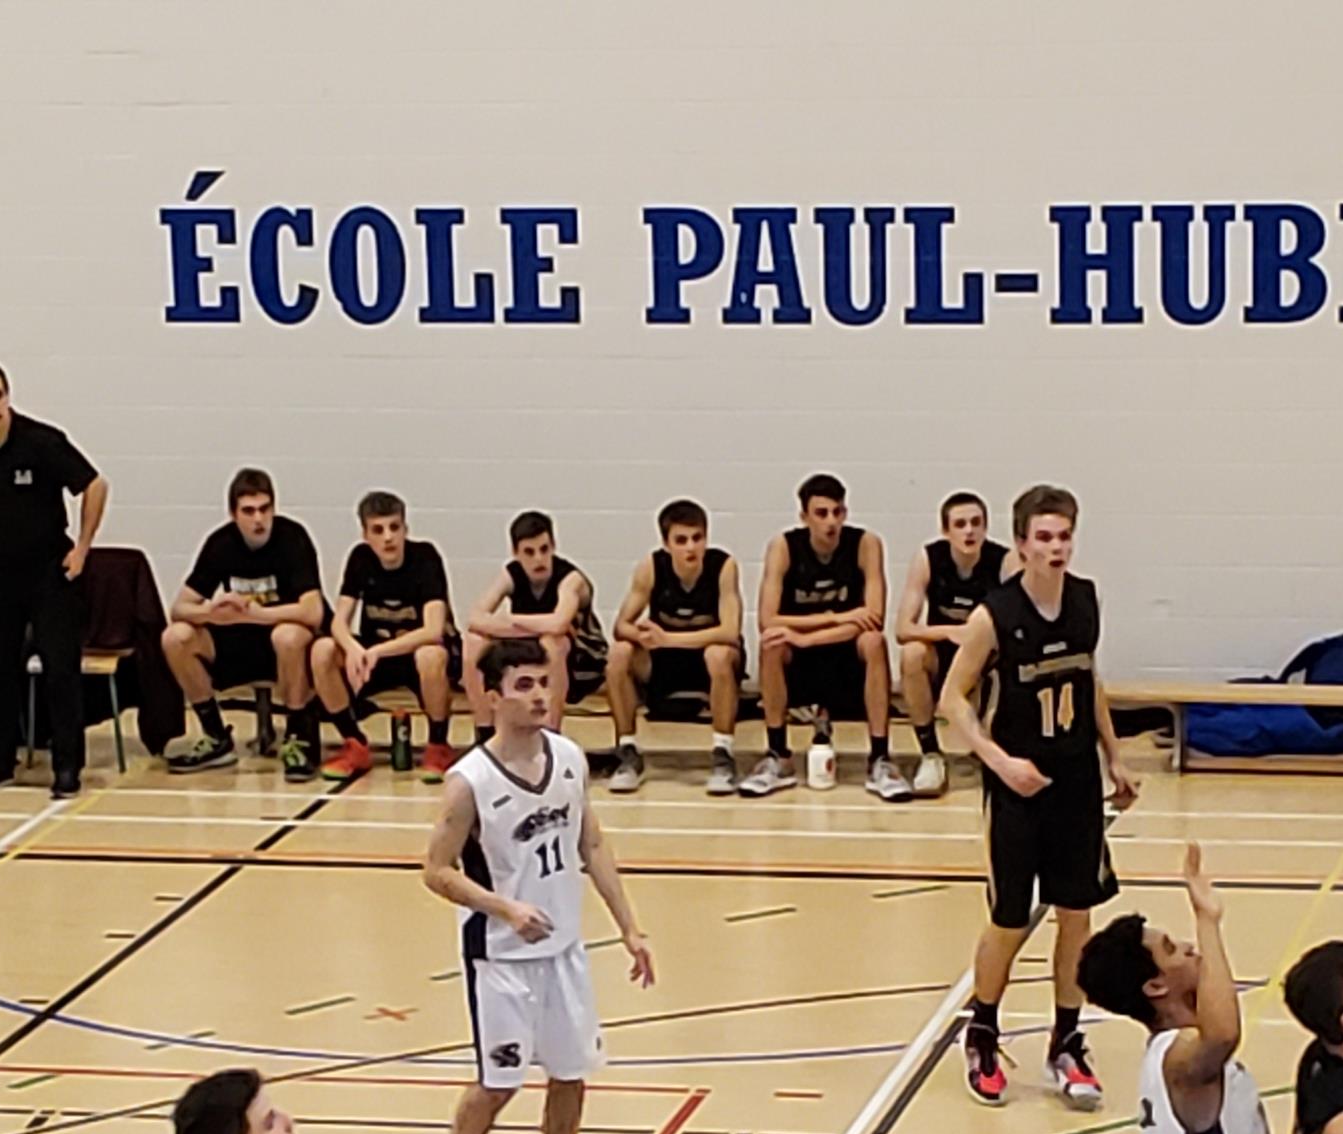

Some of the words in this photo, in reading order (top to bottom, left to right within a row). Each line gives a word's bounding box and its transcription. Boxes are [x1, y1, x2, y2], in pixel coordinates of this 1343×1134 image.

[160, 173, 580, 324] ÉCOLE
[1037, 681, 1075, 738] 14
[534, 835, 565, 879] 11
